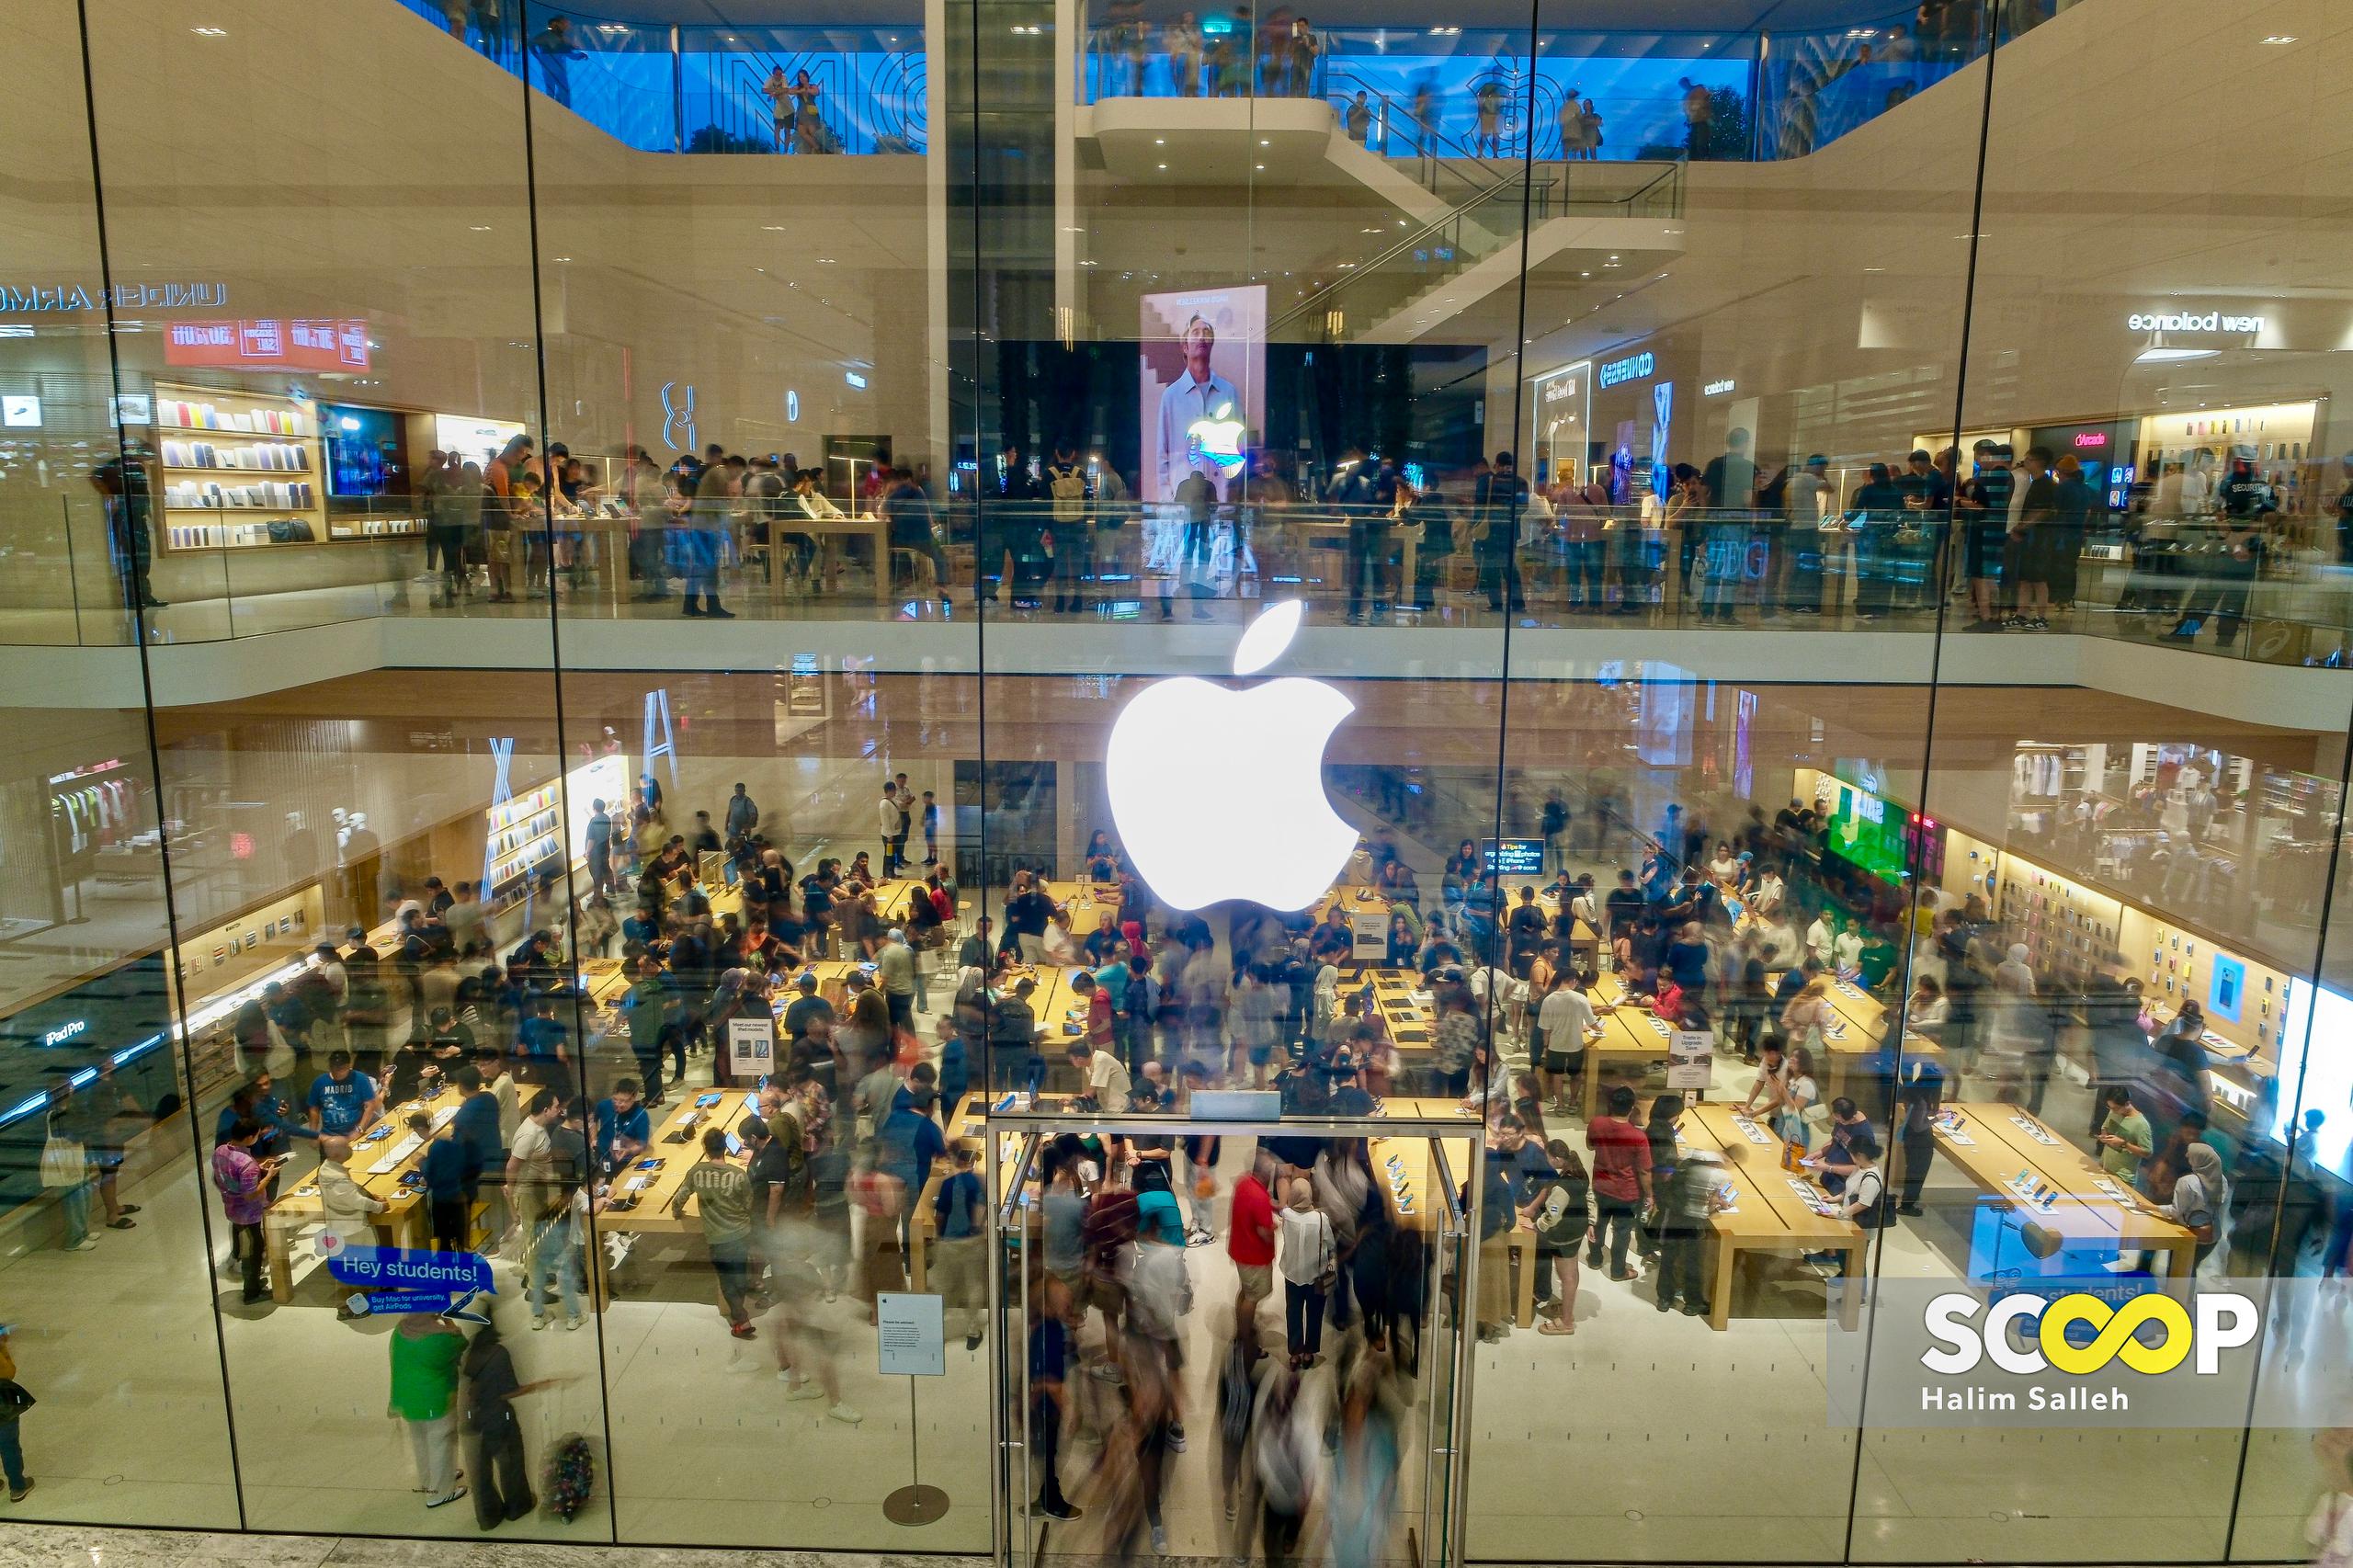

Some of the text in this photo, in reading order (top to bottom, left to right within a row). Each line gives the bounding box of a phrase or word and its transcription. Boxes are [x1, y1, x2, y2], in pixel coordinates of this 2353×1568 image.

[46, 1021, 85, 1046] iPad Pro
[324, 1085, 353, 1095] MADRID
[343, 1256, 477, 1282] Hey students!
